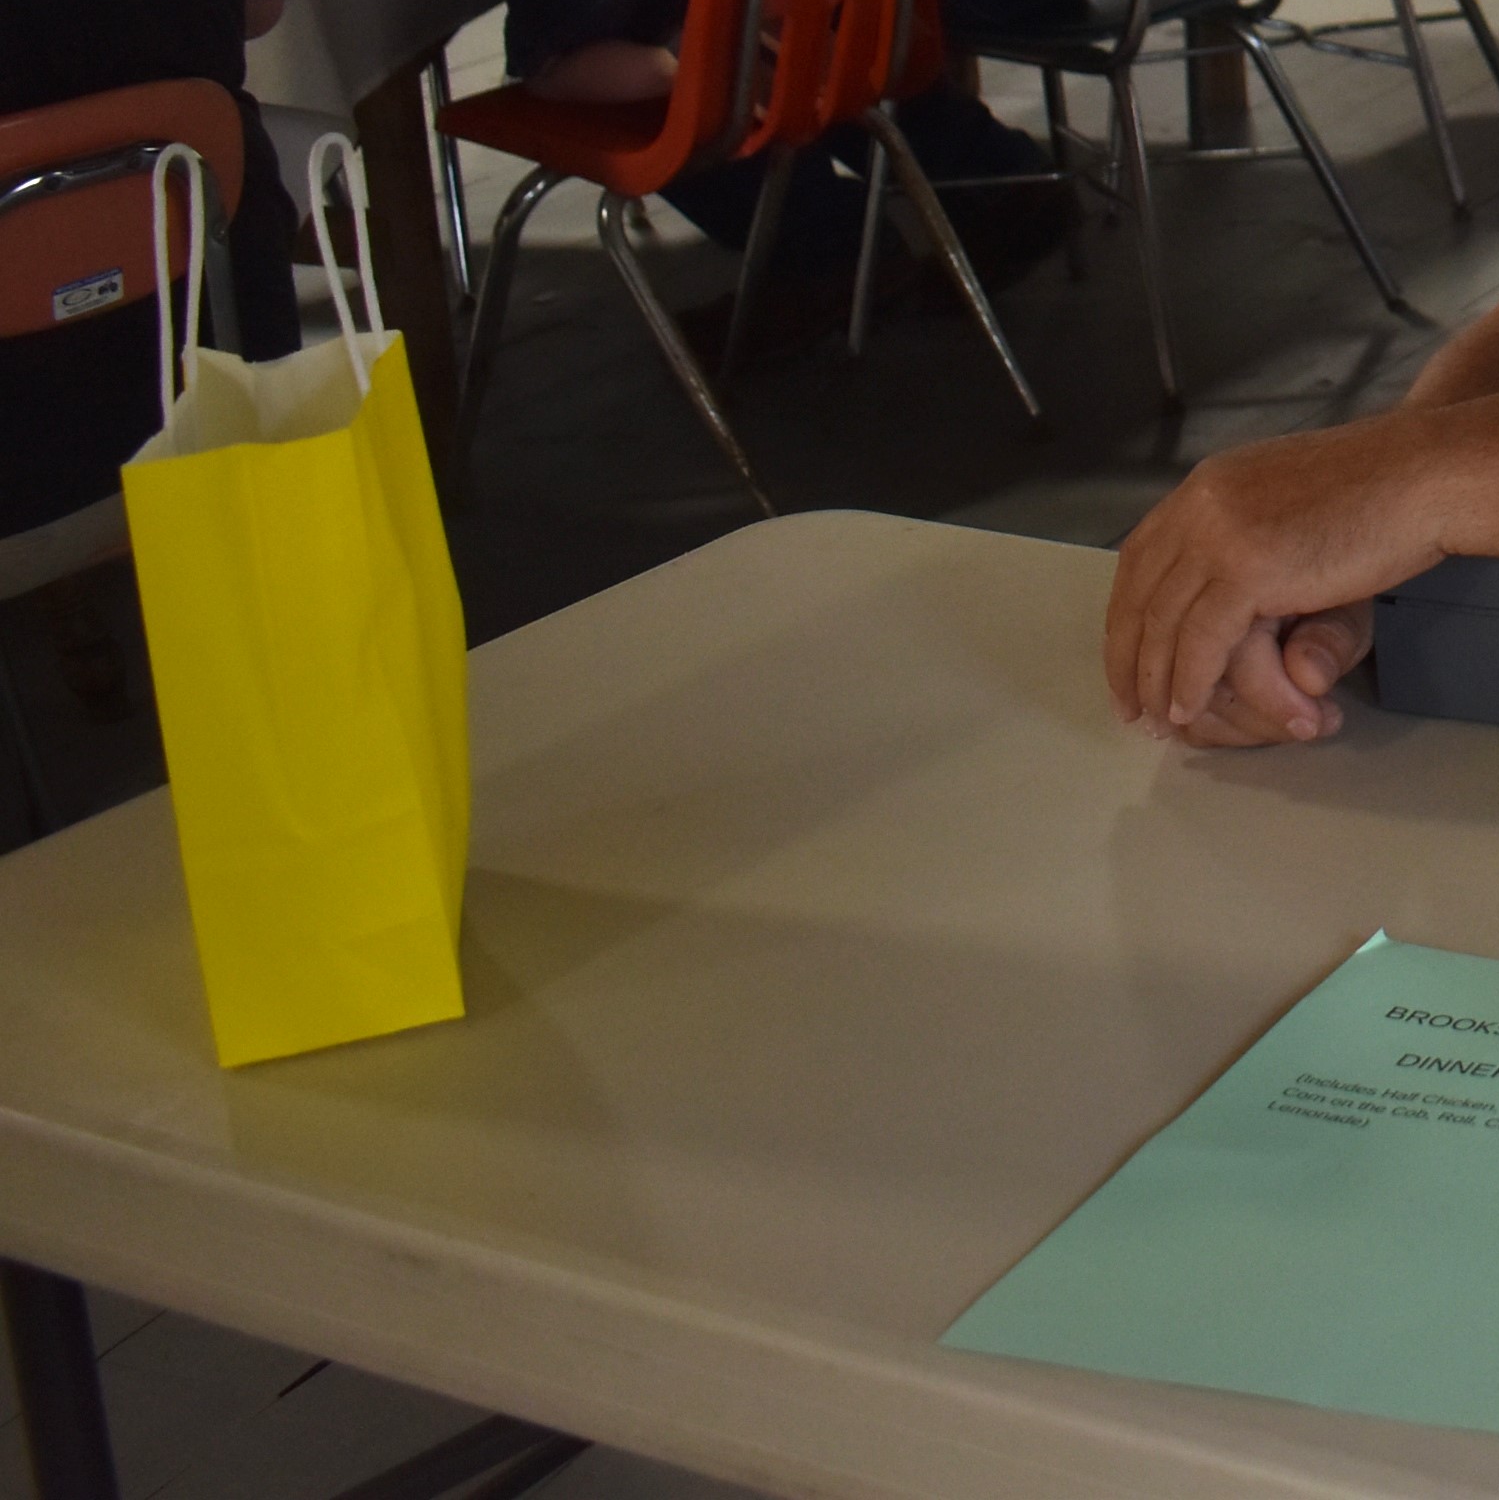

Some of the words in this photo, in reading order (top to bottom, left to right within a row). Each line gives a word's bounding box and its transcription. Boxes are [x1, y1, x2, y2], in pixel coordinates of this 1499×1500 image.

[1282, 1086, 1326, 1103] Corn
[1330, 1096, 1354, 1109] on
[1357, 1100, 1387, 1114] the
[1295, 1072, 1377, 1096] (Includes
[1381, 1087, 1421, 1102] Half
[1266, 1099, 1371, 1128] Lemonade)
